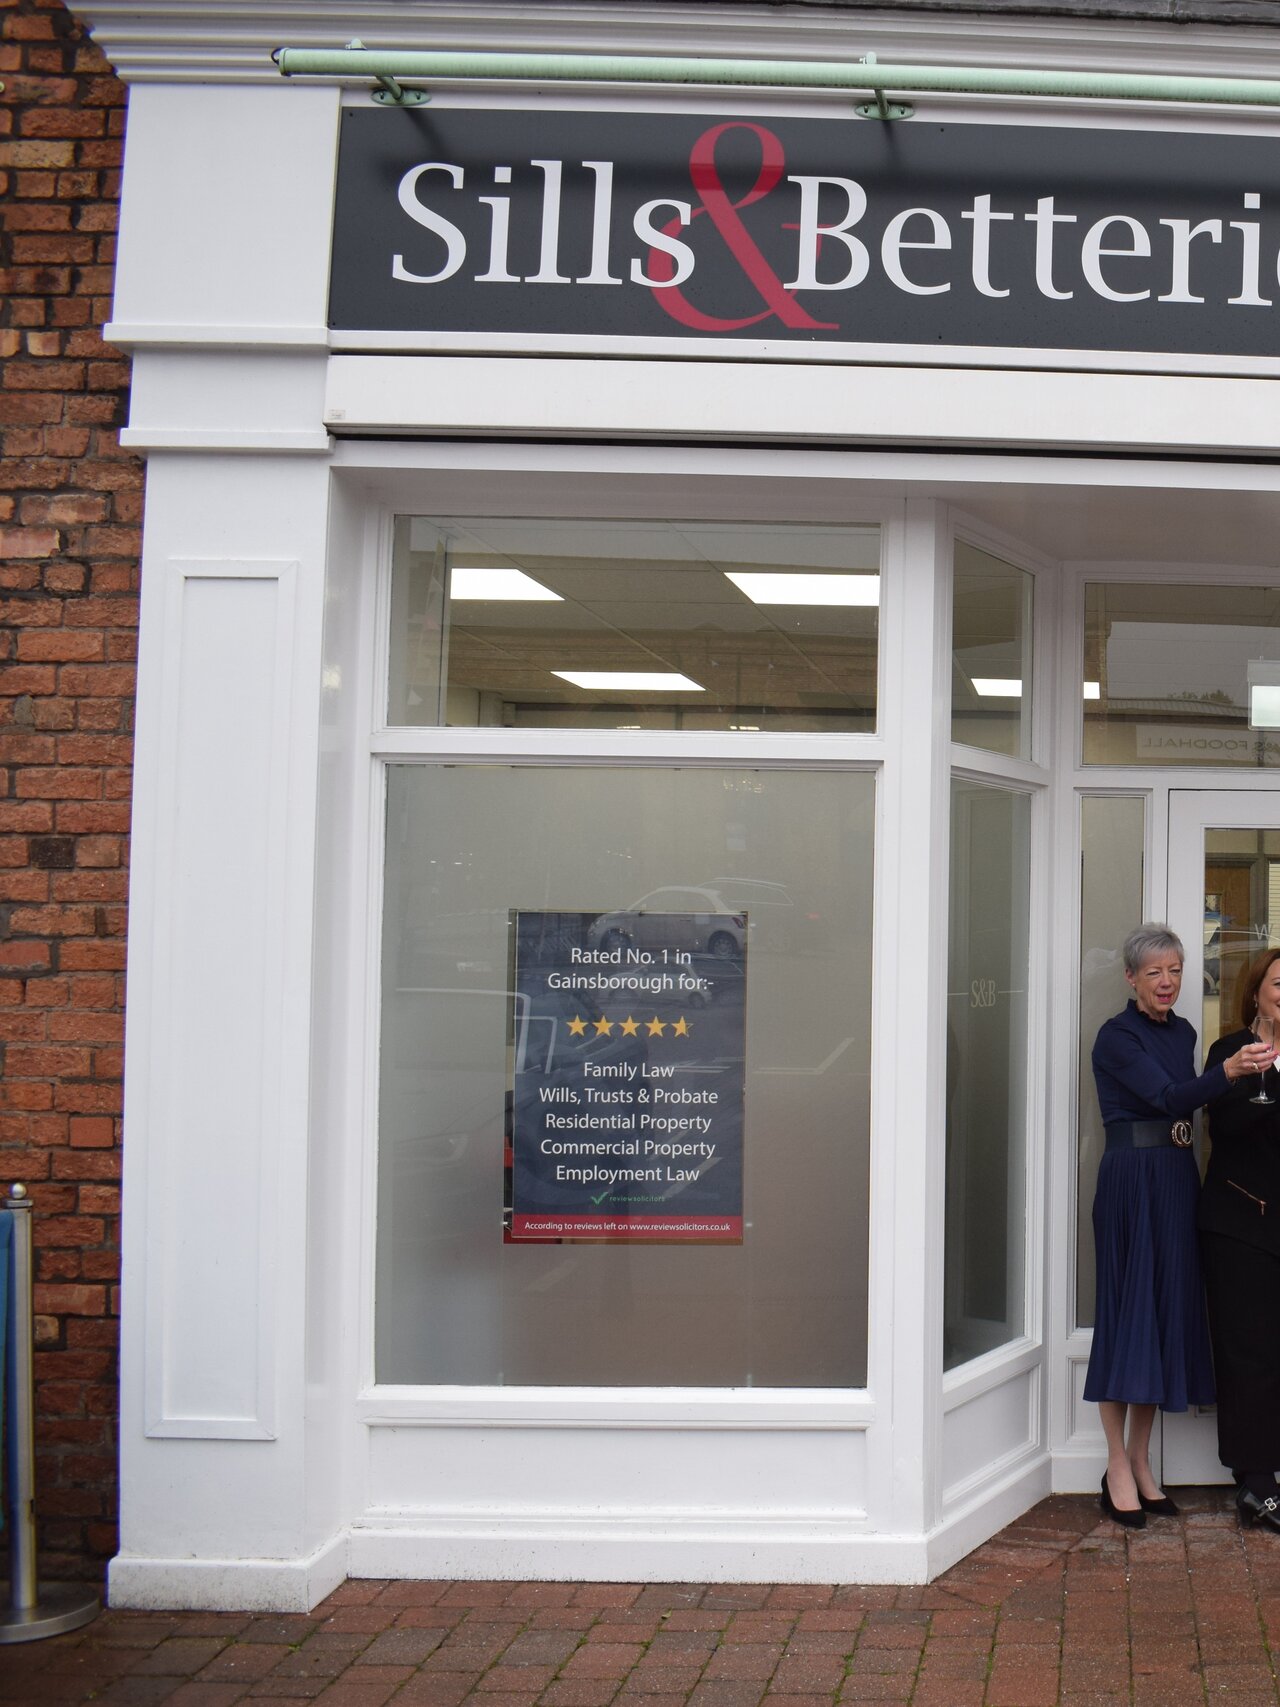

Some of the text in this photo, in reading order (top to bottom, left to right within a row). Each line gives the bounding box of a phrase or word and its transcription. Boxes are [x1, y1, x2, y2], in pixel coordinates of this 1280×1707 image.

[391, 159, 696, 288] Sills
[646, 121, 840, 332] &
[571, 947, 692, 965] Rated No. 1 in
[547, 971, 715, 994] Gainsborough for:-
[970, 978, 996, 1008] S&B
[583, 1061, 675, 1082] Family Law
[538, 1086, 719, 1106] Wills, Trusts & Probate
[545, 1112, 713, 1134] Residential Property
[540, 1138, 717, 1160] Commercial Property
[556, 1164, 701, 1185] Employment Law
[609, 1194, 666, 1203] reviewsolicitors
[524, 1221, 563, 1232] According
[564, 1222, 573, 1230] to
[574, 1222, 602, 1230] reviews
[603, 1221, 617, 1231] left
[629, 1221, 731, 1232] www.reviewsolicitors.co.uk
